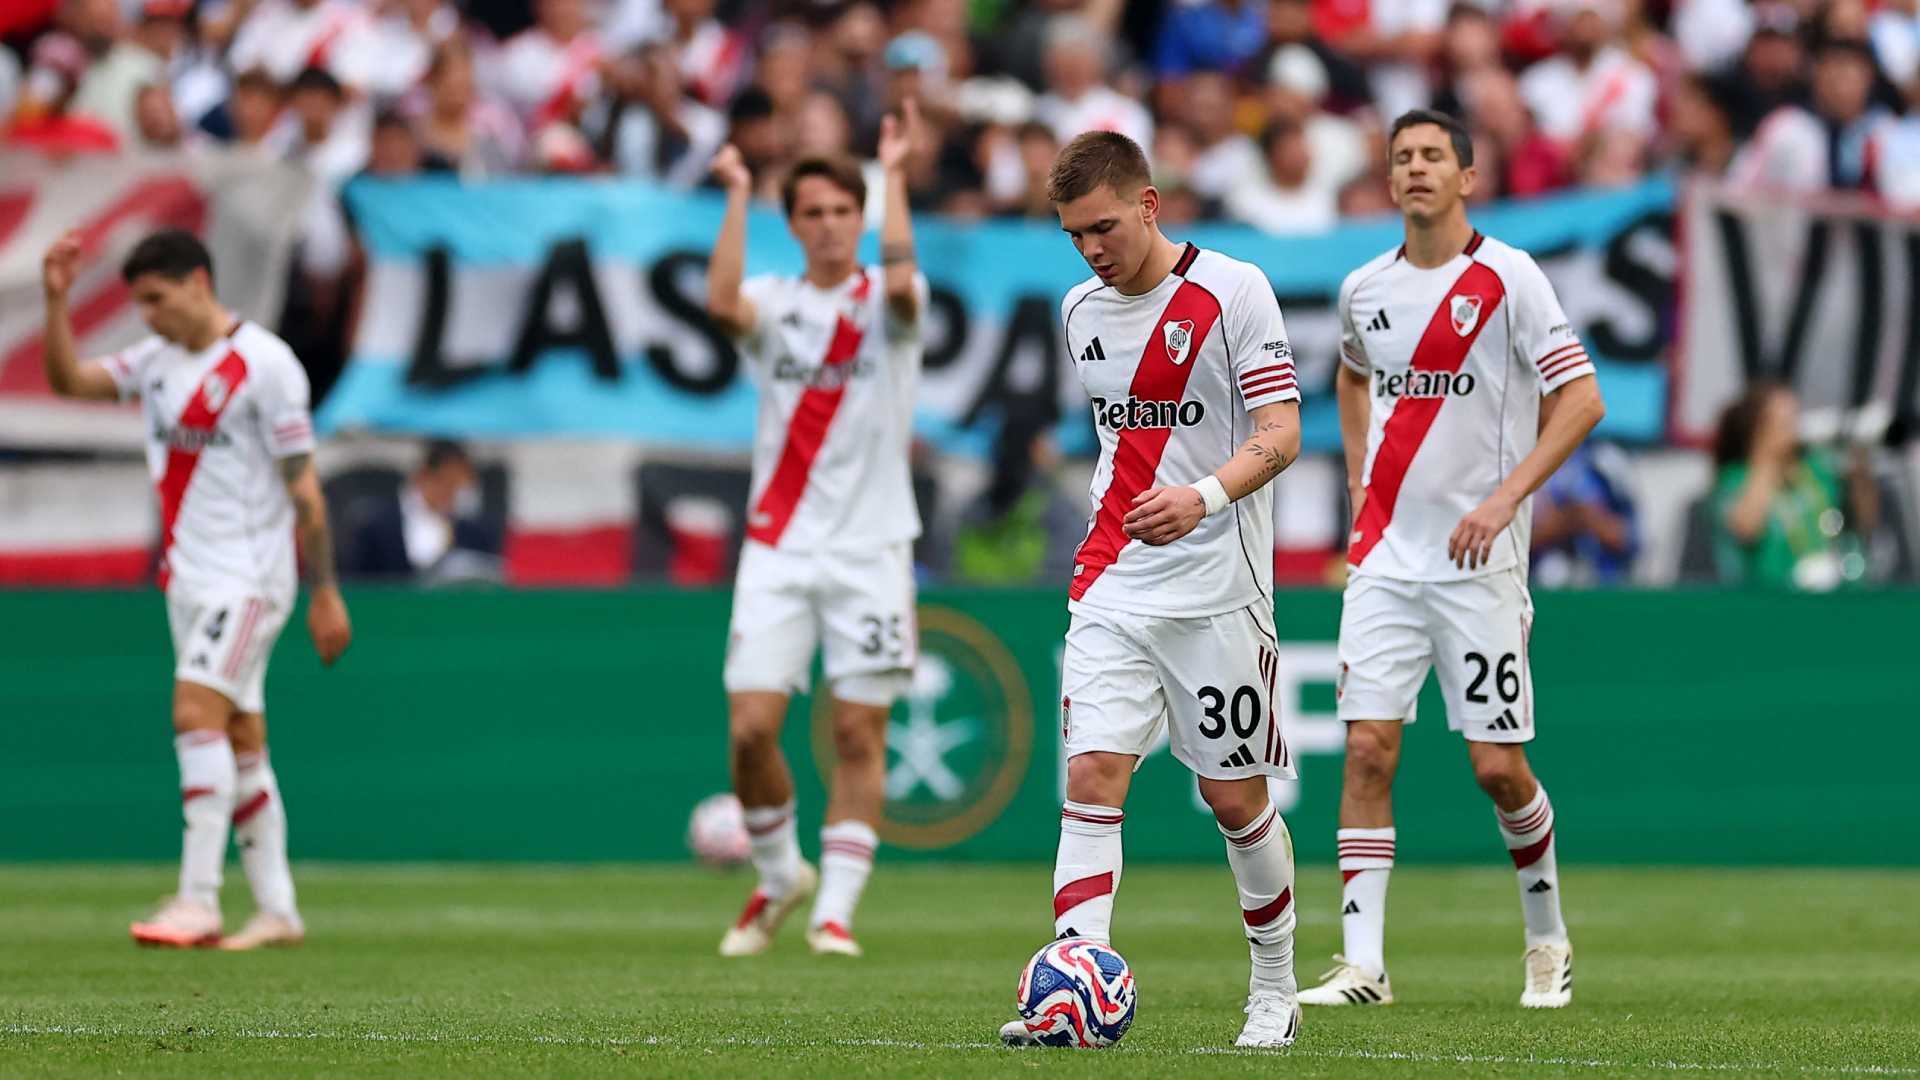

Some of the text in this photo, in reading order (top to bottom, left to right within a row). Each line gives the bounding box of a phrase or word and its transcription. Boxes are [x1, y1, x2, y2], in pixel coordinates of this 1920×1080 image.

[404, 238, 738, 398] LAS
[859, 613, 904, 658] 35
[1464, 652, 1519, 704] 26
[1197, 685, 1261, 739] 30
